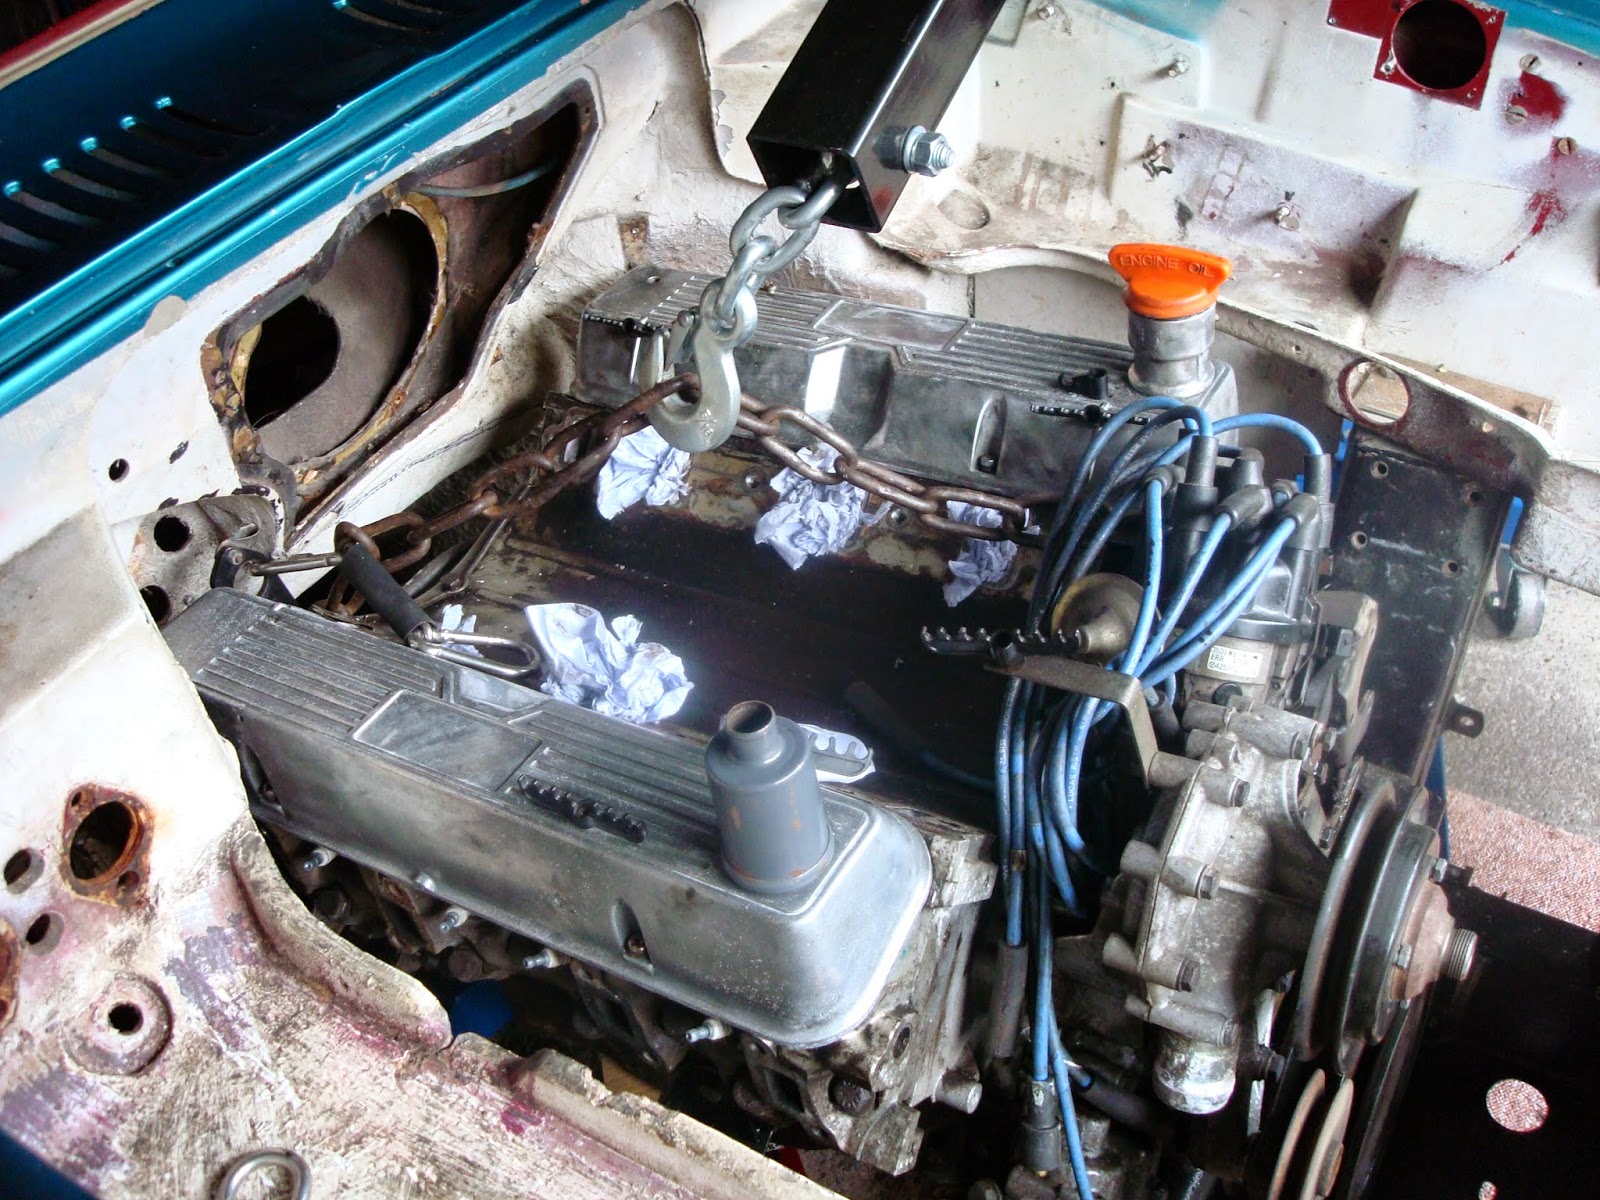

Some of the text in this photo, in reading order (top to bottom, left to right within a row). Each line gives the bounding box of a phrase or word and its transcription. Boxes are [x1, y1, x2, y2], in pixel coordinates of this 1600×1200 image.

[1119, 254, 1215, 278] ENGINE OIL
[1067, 774, 1076, 802] LUCAS
